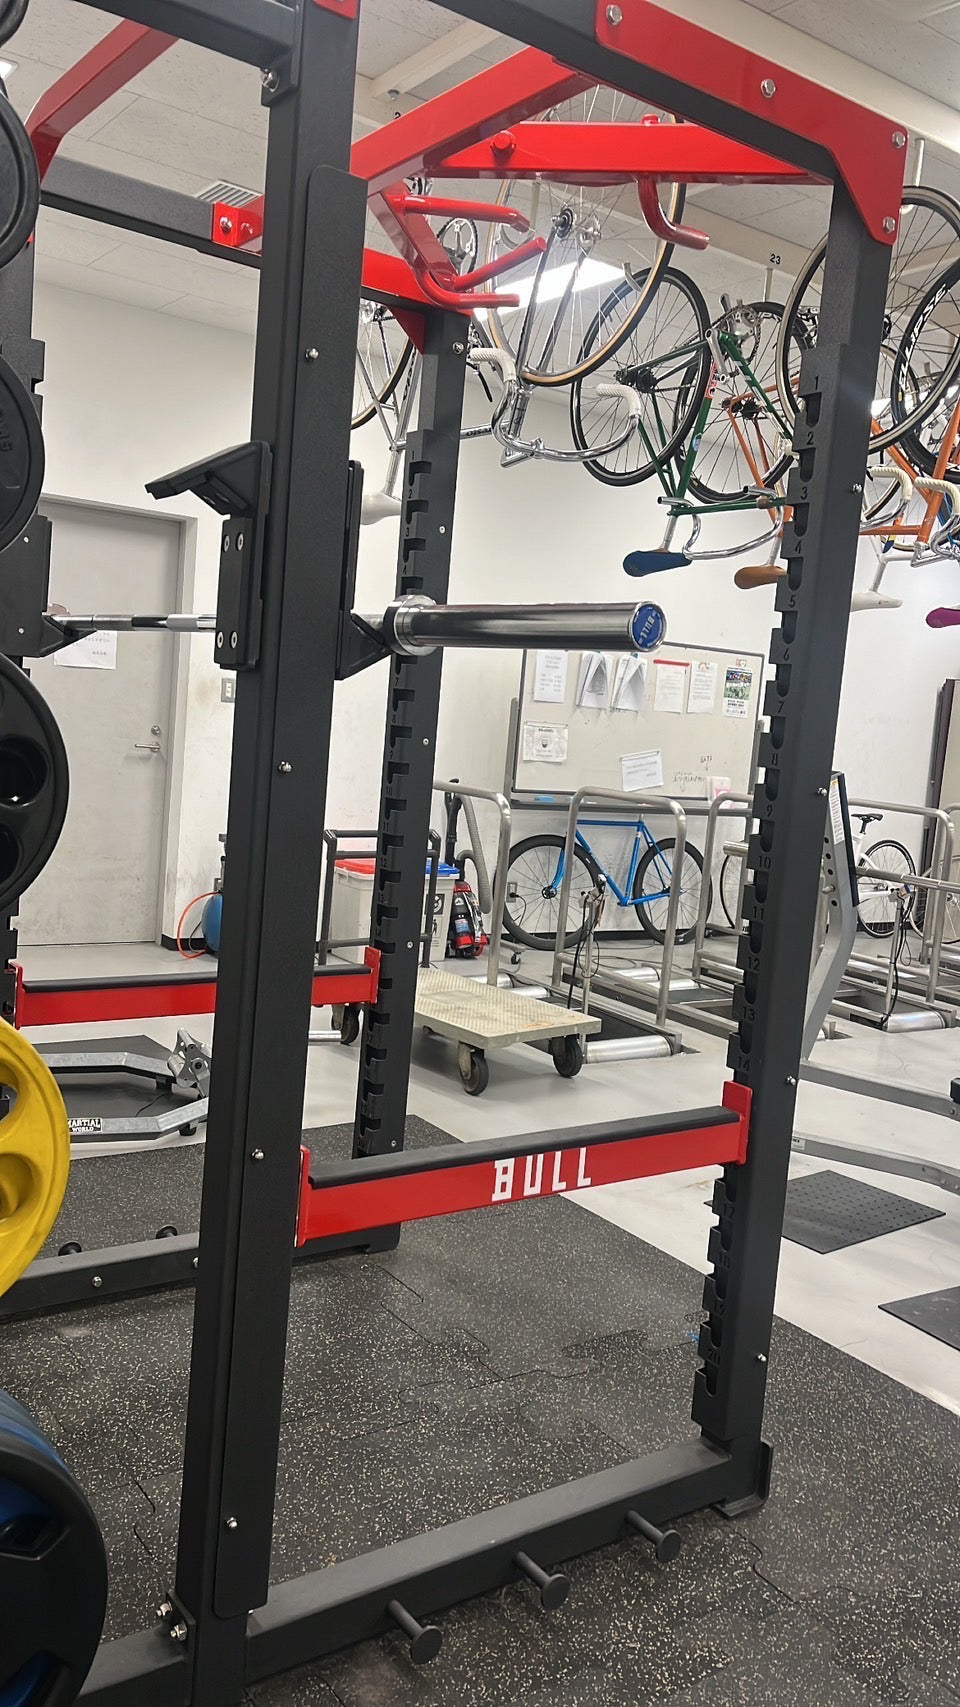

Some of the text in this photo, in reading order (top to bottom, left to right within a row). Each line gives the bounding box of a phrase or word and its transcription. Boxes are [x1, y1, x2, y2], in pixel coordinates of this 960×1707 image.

[770, 254, 781, 264] 23
[814, 376, 819, 390] 1
[806, 432, 814, 446] 2
[800, 486, 808, 500] 3
[788, 594, 796, 608] 5
[640, 616, 655, 638] BULL
[783, 648, 789, 662] 6
[777, 701, 784, 714] 7
[766, 804, 773, 818] 9
[758, 855, 771, 869] 10
[752, 906, 764, 920] 11
[747, 956, 760, 971] 12
[742, 1007, 756, 1021] 13
[737, 1056, 750, 1072] 14
[492, 1147, 592, 1202] BULL
